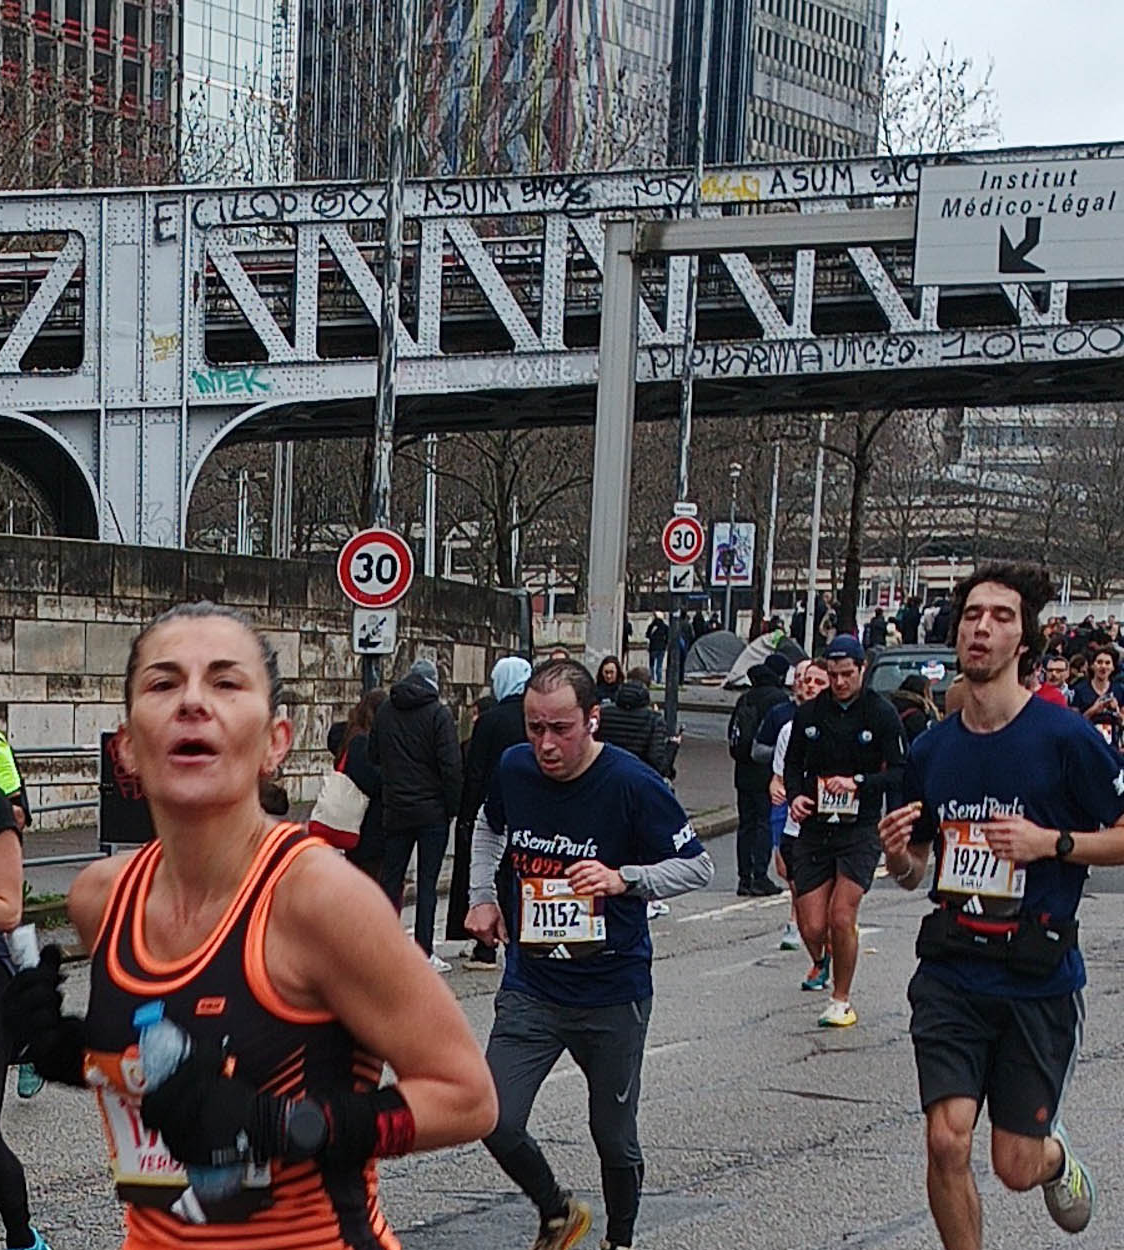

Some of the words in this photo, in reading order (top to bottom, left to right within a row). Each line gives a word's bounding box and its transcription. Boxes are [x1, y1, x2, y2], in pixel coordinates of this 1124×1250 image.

[980, 168, 1078, 190] Institut
[941, 190, 1117, 219] Médico-Légal
[672, 529, 696, 551] 30
[353, 551, 399, 586] 30
[532, 902, 580, 928] 21152
